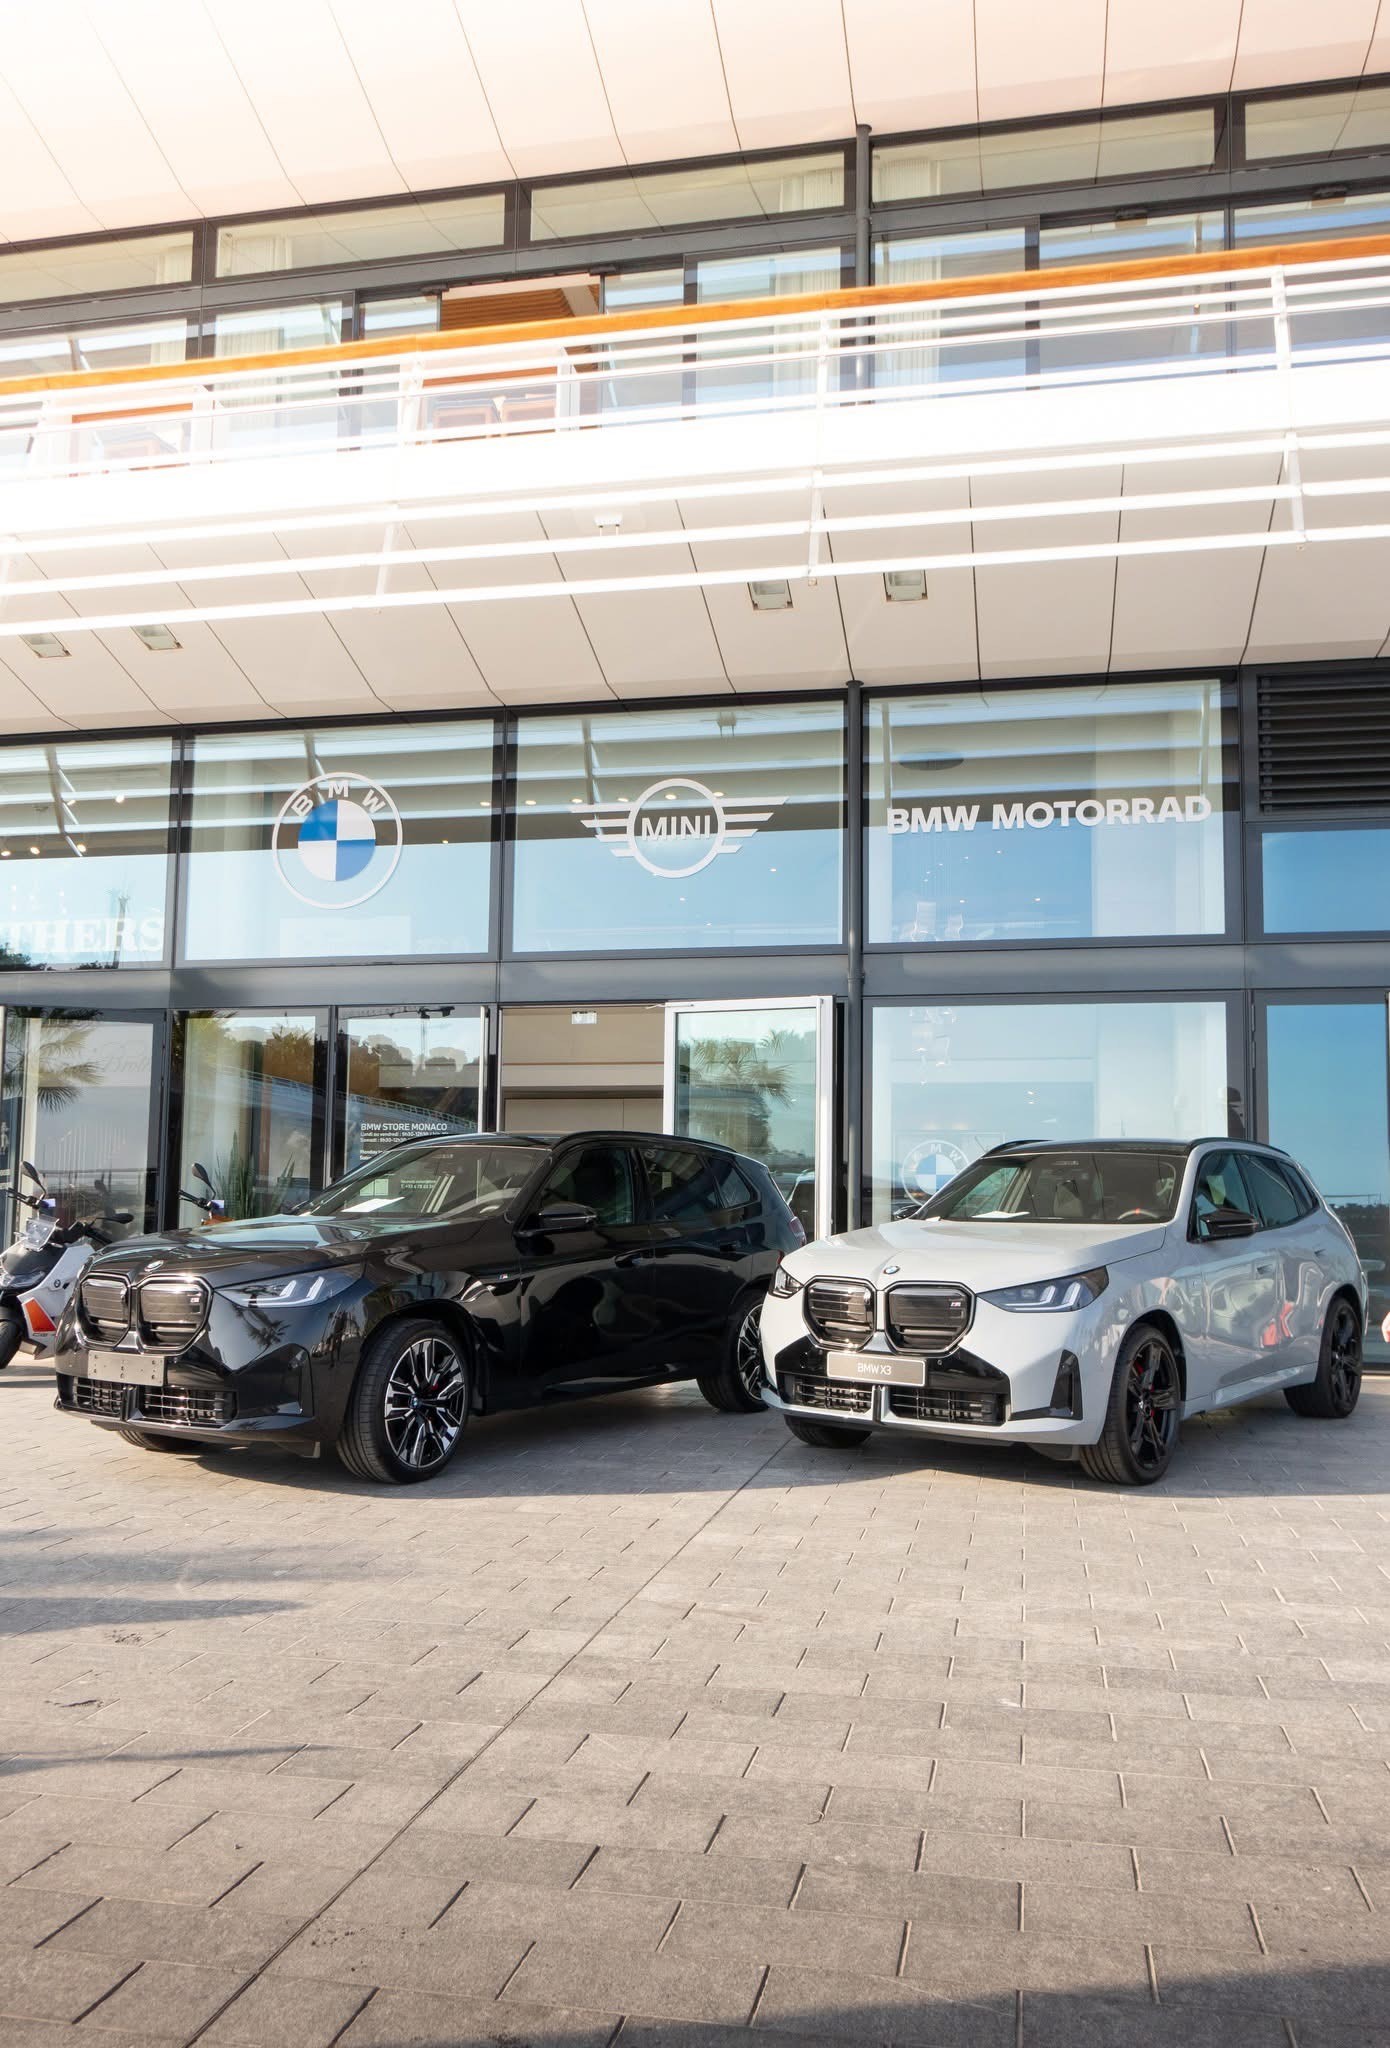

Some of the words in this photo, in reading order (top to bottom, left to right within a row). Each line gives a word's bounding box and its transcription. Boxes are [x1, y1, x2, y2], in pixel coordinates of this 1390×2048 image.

[291, 780, 386, 816] BMW
[641, 815, 711, 841] MINI
[888, 804, 980, 834] BMW
[992, 796, 1212, 830] MOTORRAD
[361, 1123, 381, 1131] BMW
[382, 1123, 410, 1131] STORE
[411, 1123, 447, 1131] MONACO
[857, 1363, 879, 1374] BMW
[880, 1365, 892, 1376] X3
